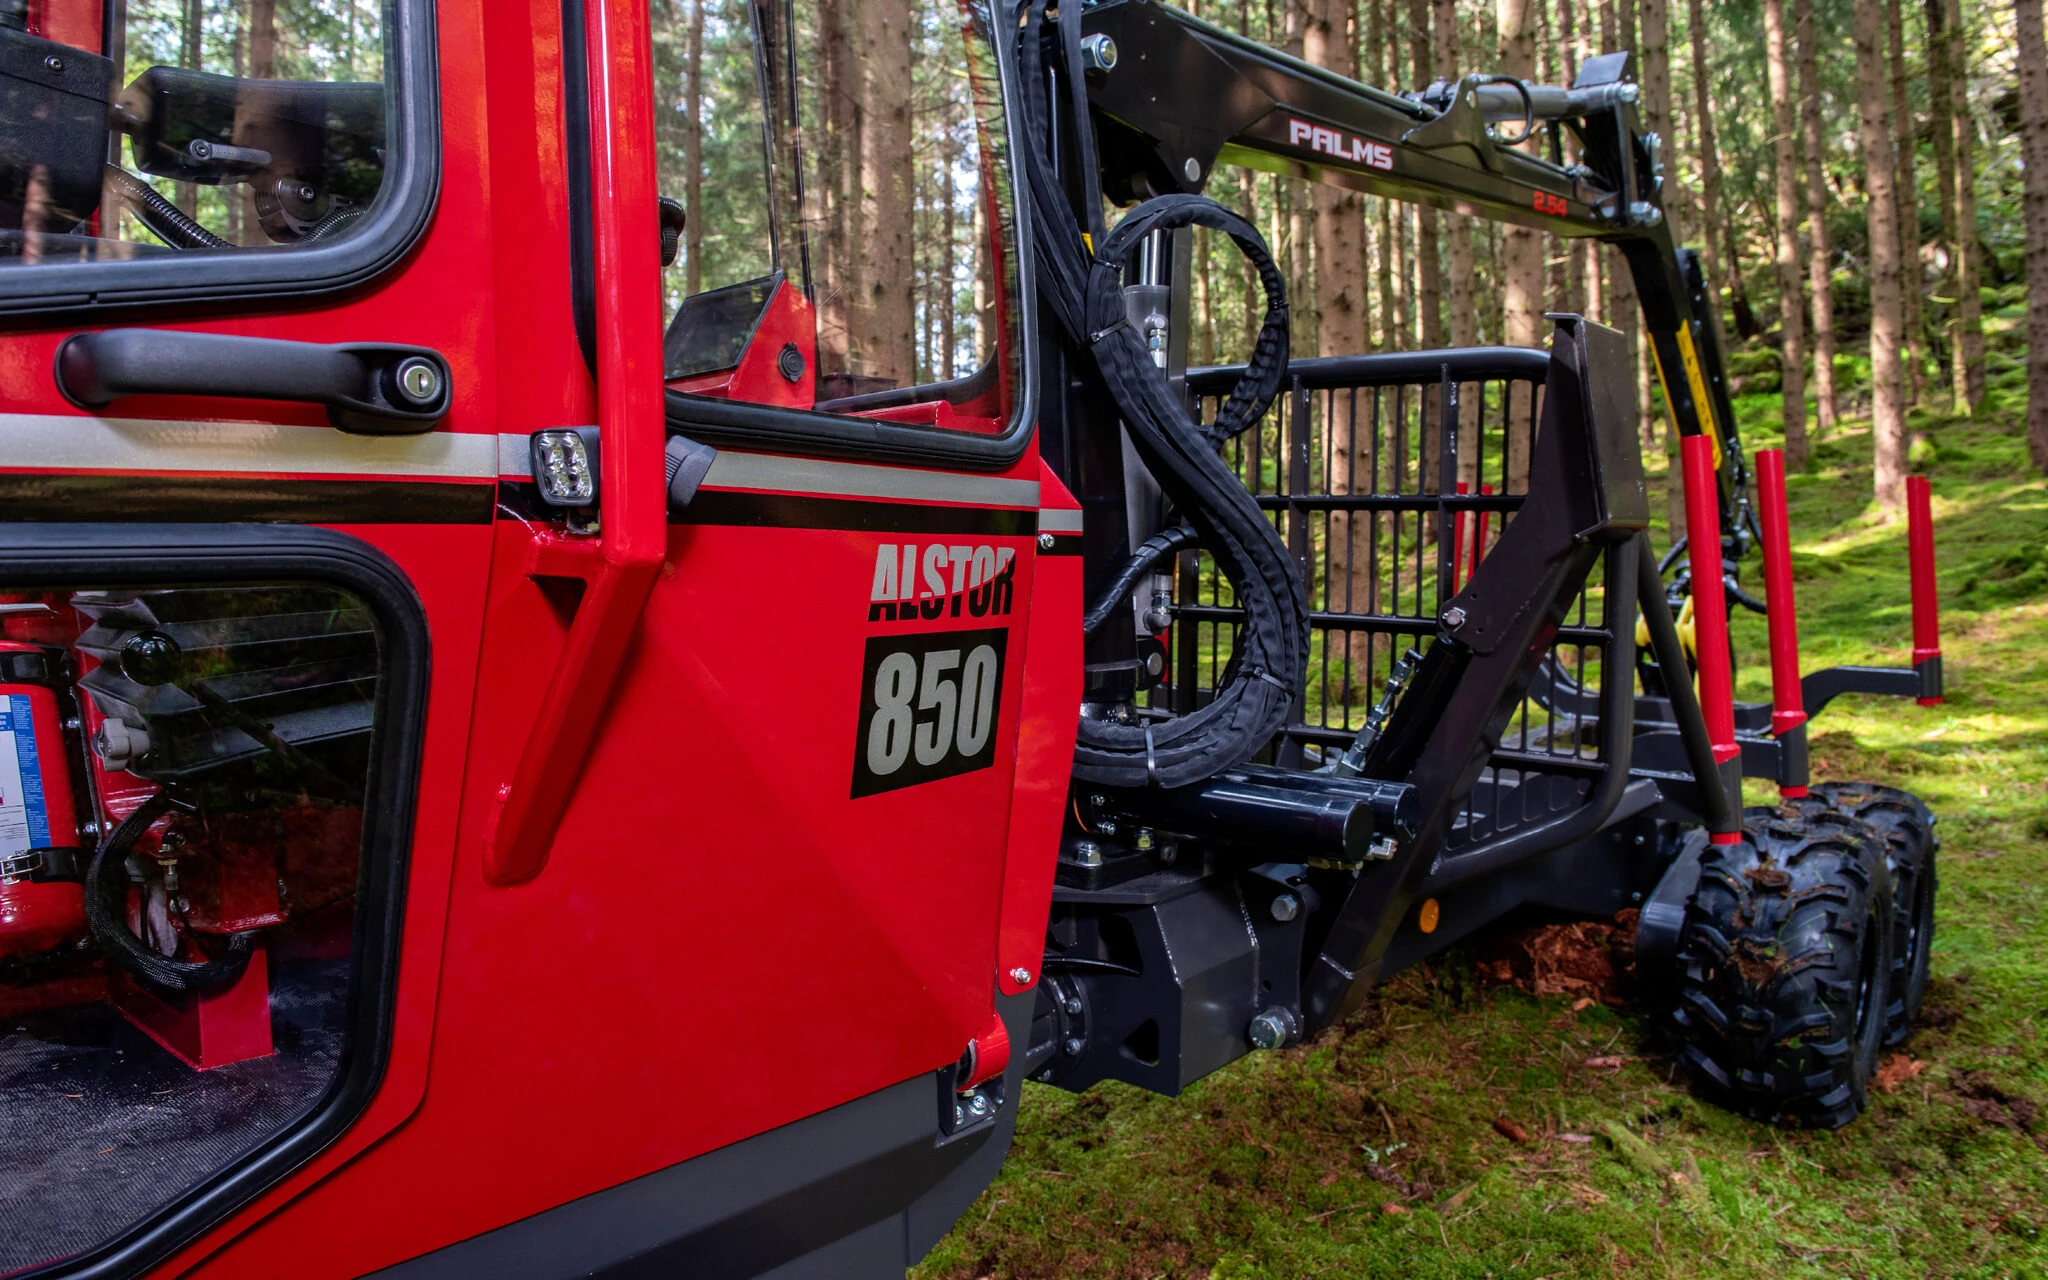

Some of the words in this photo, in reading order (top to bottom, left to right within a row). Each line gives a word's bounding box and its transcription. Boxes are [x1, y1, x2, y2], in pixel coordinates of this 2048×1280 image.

[1289, 119, 1393, 171] PALMS
[1533, 189, 1567, 217] 2.54
[867, 543, 1016, 622] ALSTOR
[867, 644, 997, 776] 850
